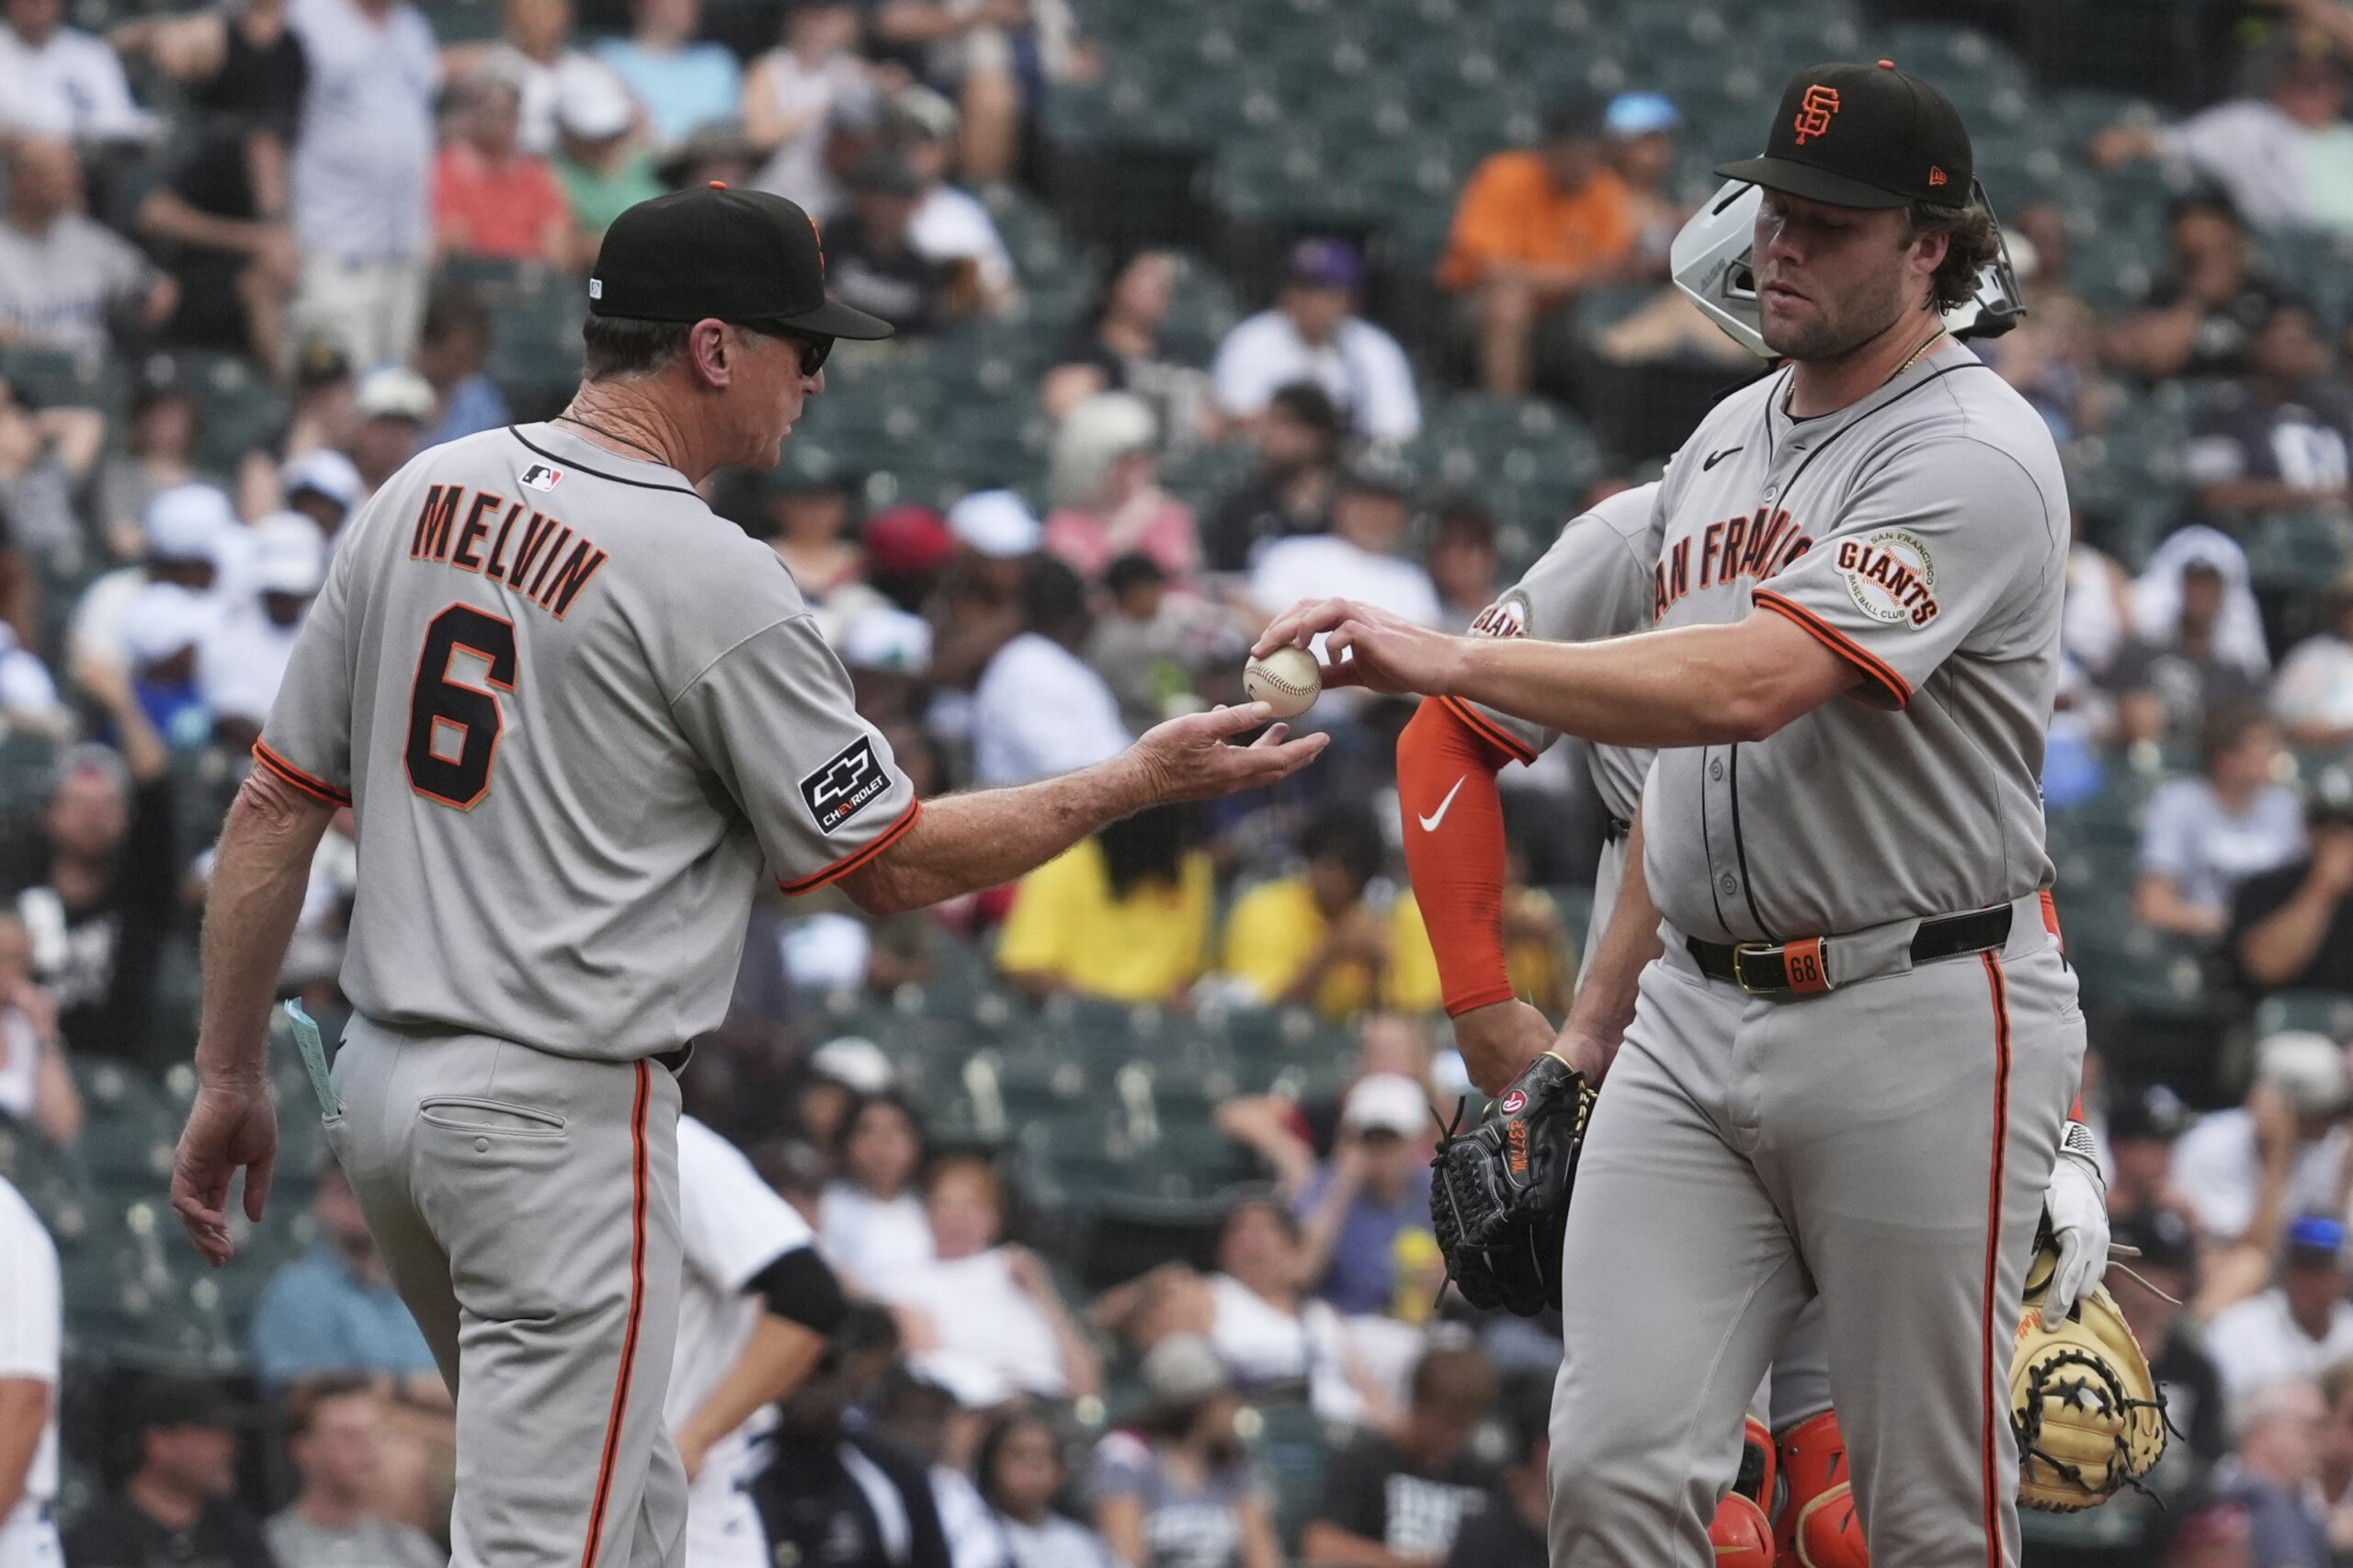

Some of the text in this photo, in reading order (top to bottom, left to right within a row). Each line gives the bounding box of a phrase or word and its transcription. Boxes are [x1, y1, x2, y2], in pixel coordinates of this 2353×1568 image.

[410, 483, 609, 621] MELVIN
[1870, 532, 1934, 585] SAN FRANCISCO
[1654, 535, 1691, 626] AN
[1837, 540, 1938, 626] GIANTS
[1847, 574, 1905, 619] BASEBALL CLUB
[1472, 608, 1523, 637] GIAN
[403, 601, 518, 812] 6
[823, 775, 882, 826] CHEVROLET
[1790, 954, 1817, 983] 68
